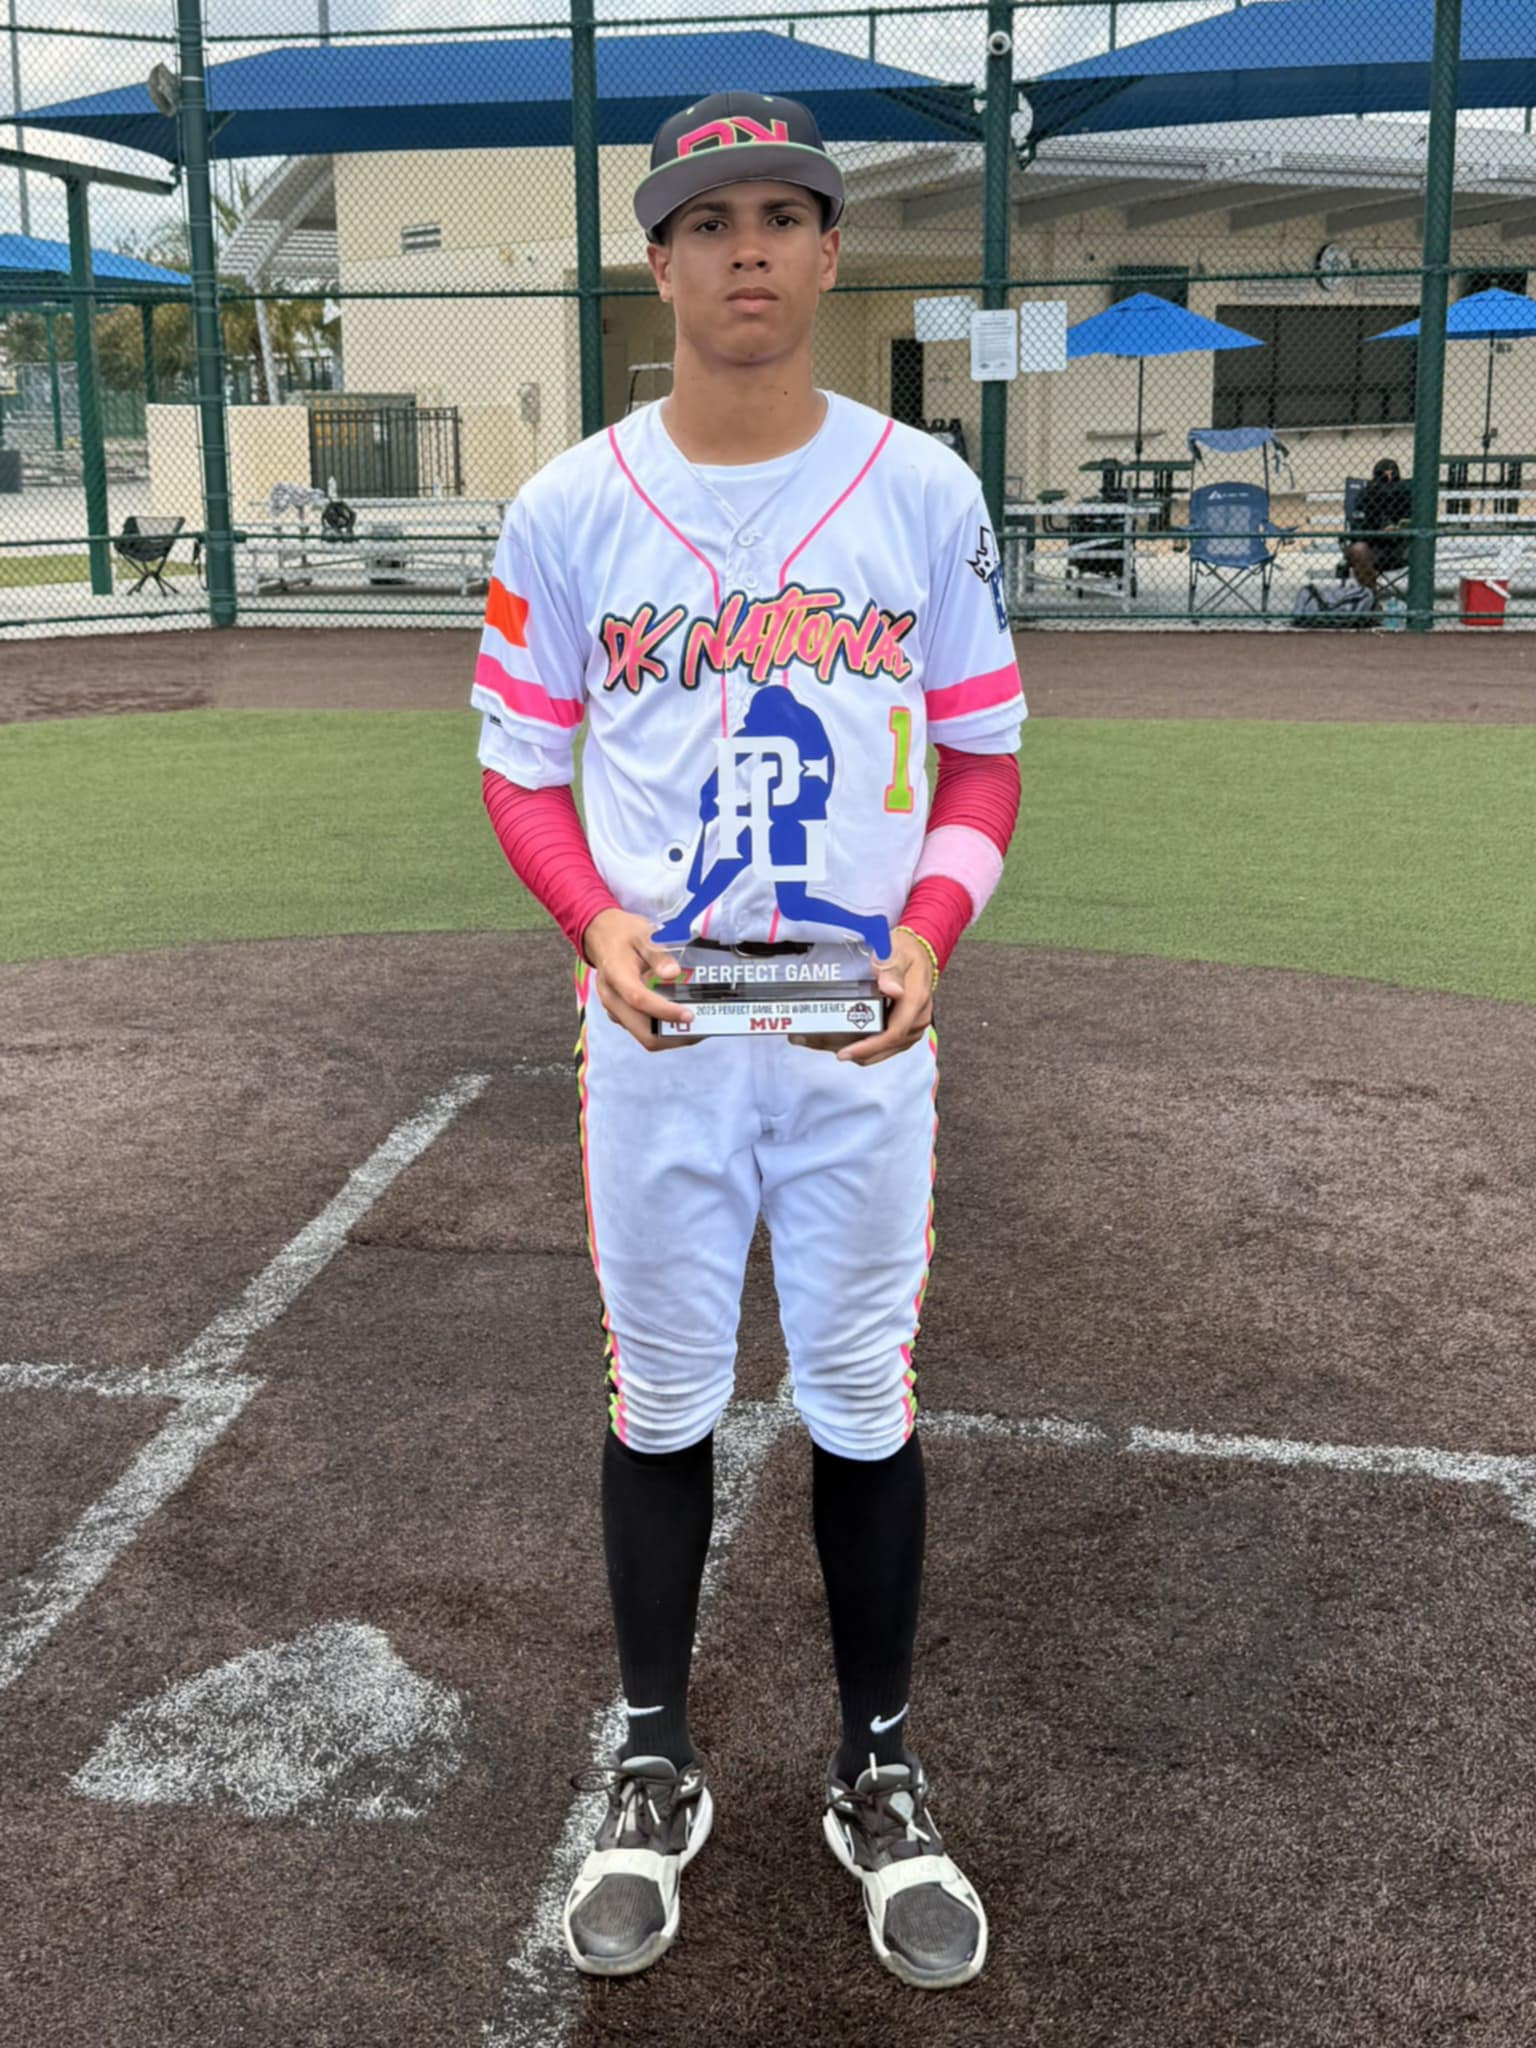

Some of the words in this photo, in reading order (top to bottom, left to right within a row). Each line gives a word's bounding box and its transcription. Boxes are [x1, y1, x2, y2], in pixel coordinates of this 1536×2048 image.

[600, 602, 689, 694] DK
[884, 706, 914, 814] 1
[694, 963, 780, 982] PERFECT
[785, 962, 841, 981] GAME
[718, 1004, 749, 1016] PERFECT
[752, 1004, 774, 1015] GAME
[792, 1003, 818, 1014] WORLD
[820, 1002, 846, 1013] SERIES
[749, 1017, 793, 1031] MVP
